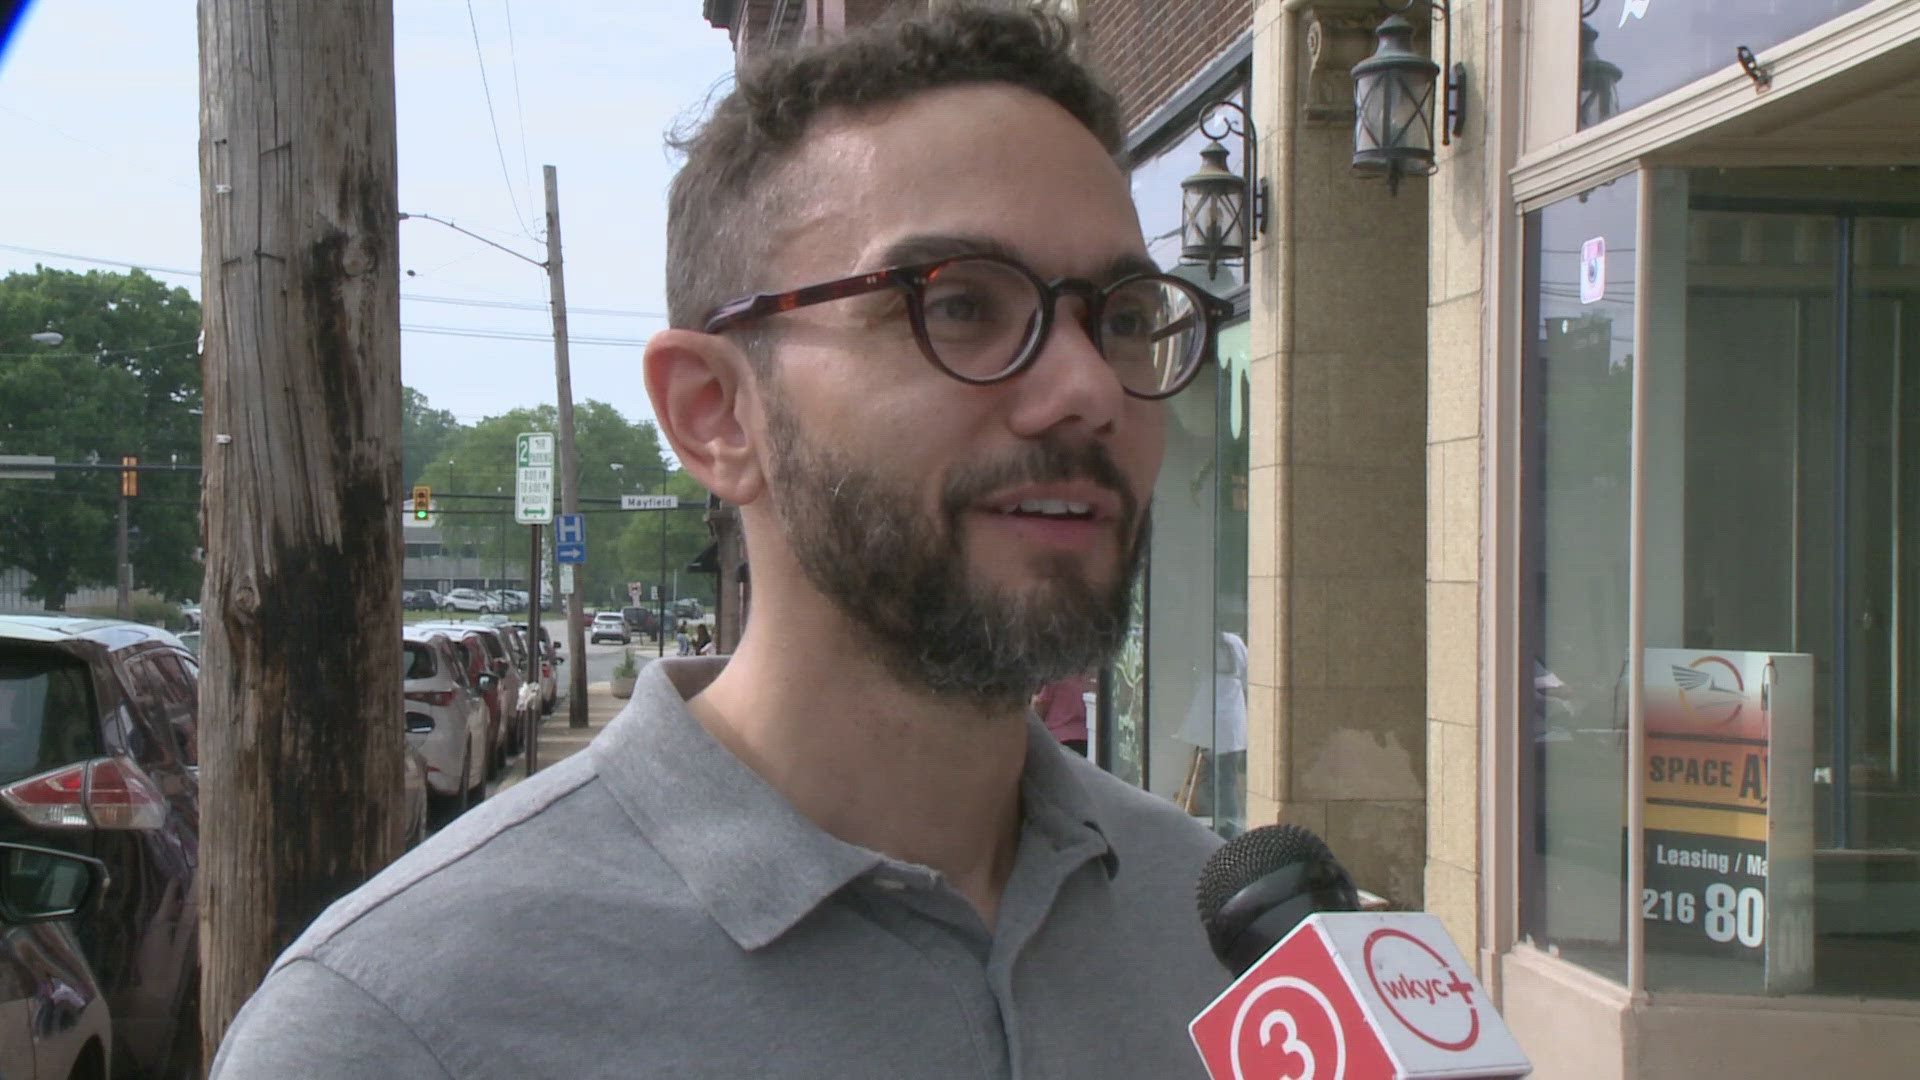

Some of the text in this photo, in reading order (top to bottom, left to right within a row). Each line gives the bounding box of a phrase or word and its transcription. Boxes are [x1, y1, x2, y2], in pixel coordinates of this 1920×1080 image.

[520, 440, 528, 462] 2
[628, 498, 671, 509] Mayfield
[559, 516, 581, 542] H
[1649, 755, 1733, 788] SPACE
[1657, 844, 1729, 874] Leasing
[1734, 851, 1742, 873] /
[1643, 882, 1764, 948] 216 80
[1259, 1009, 1316, 1080] 3
